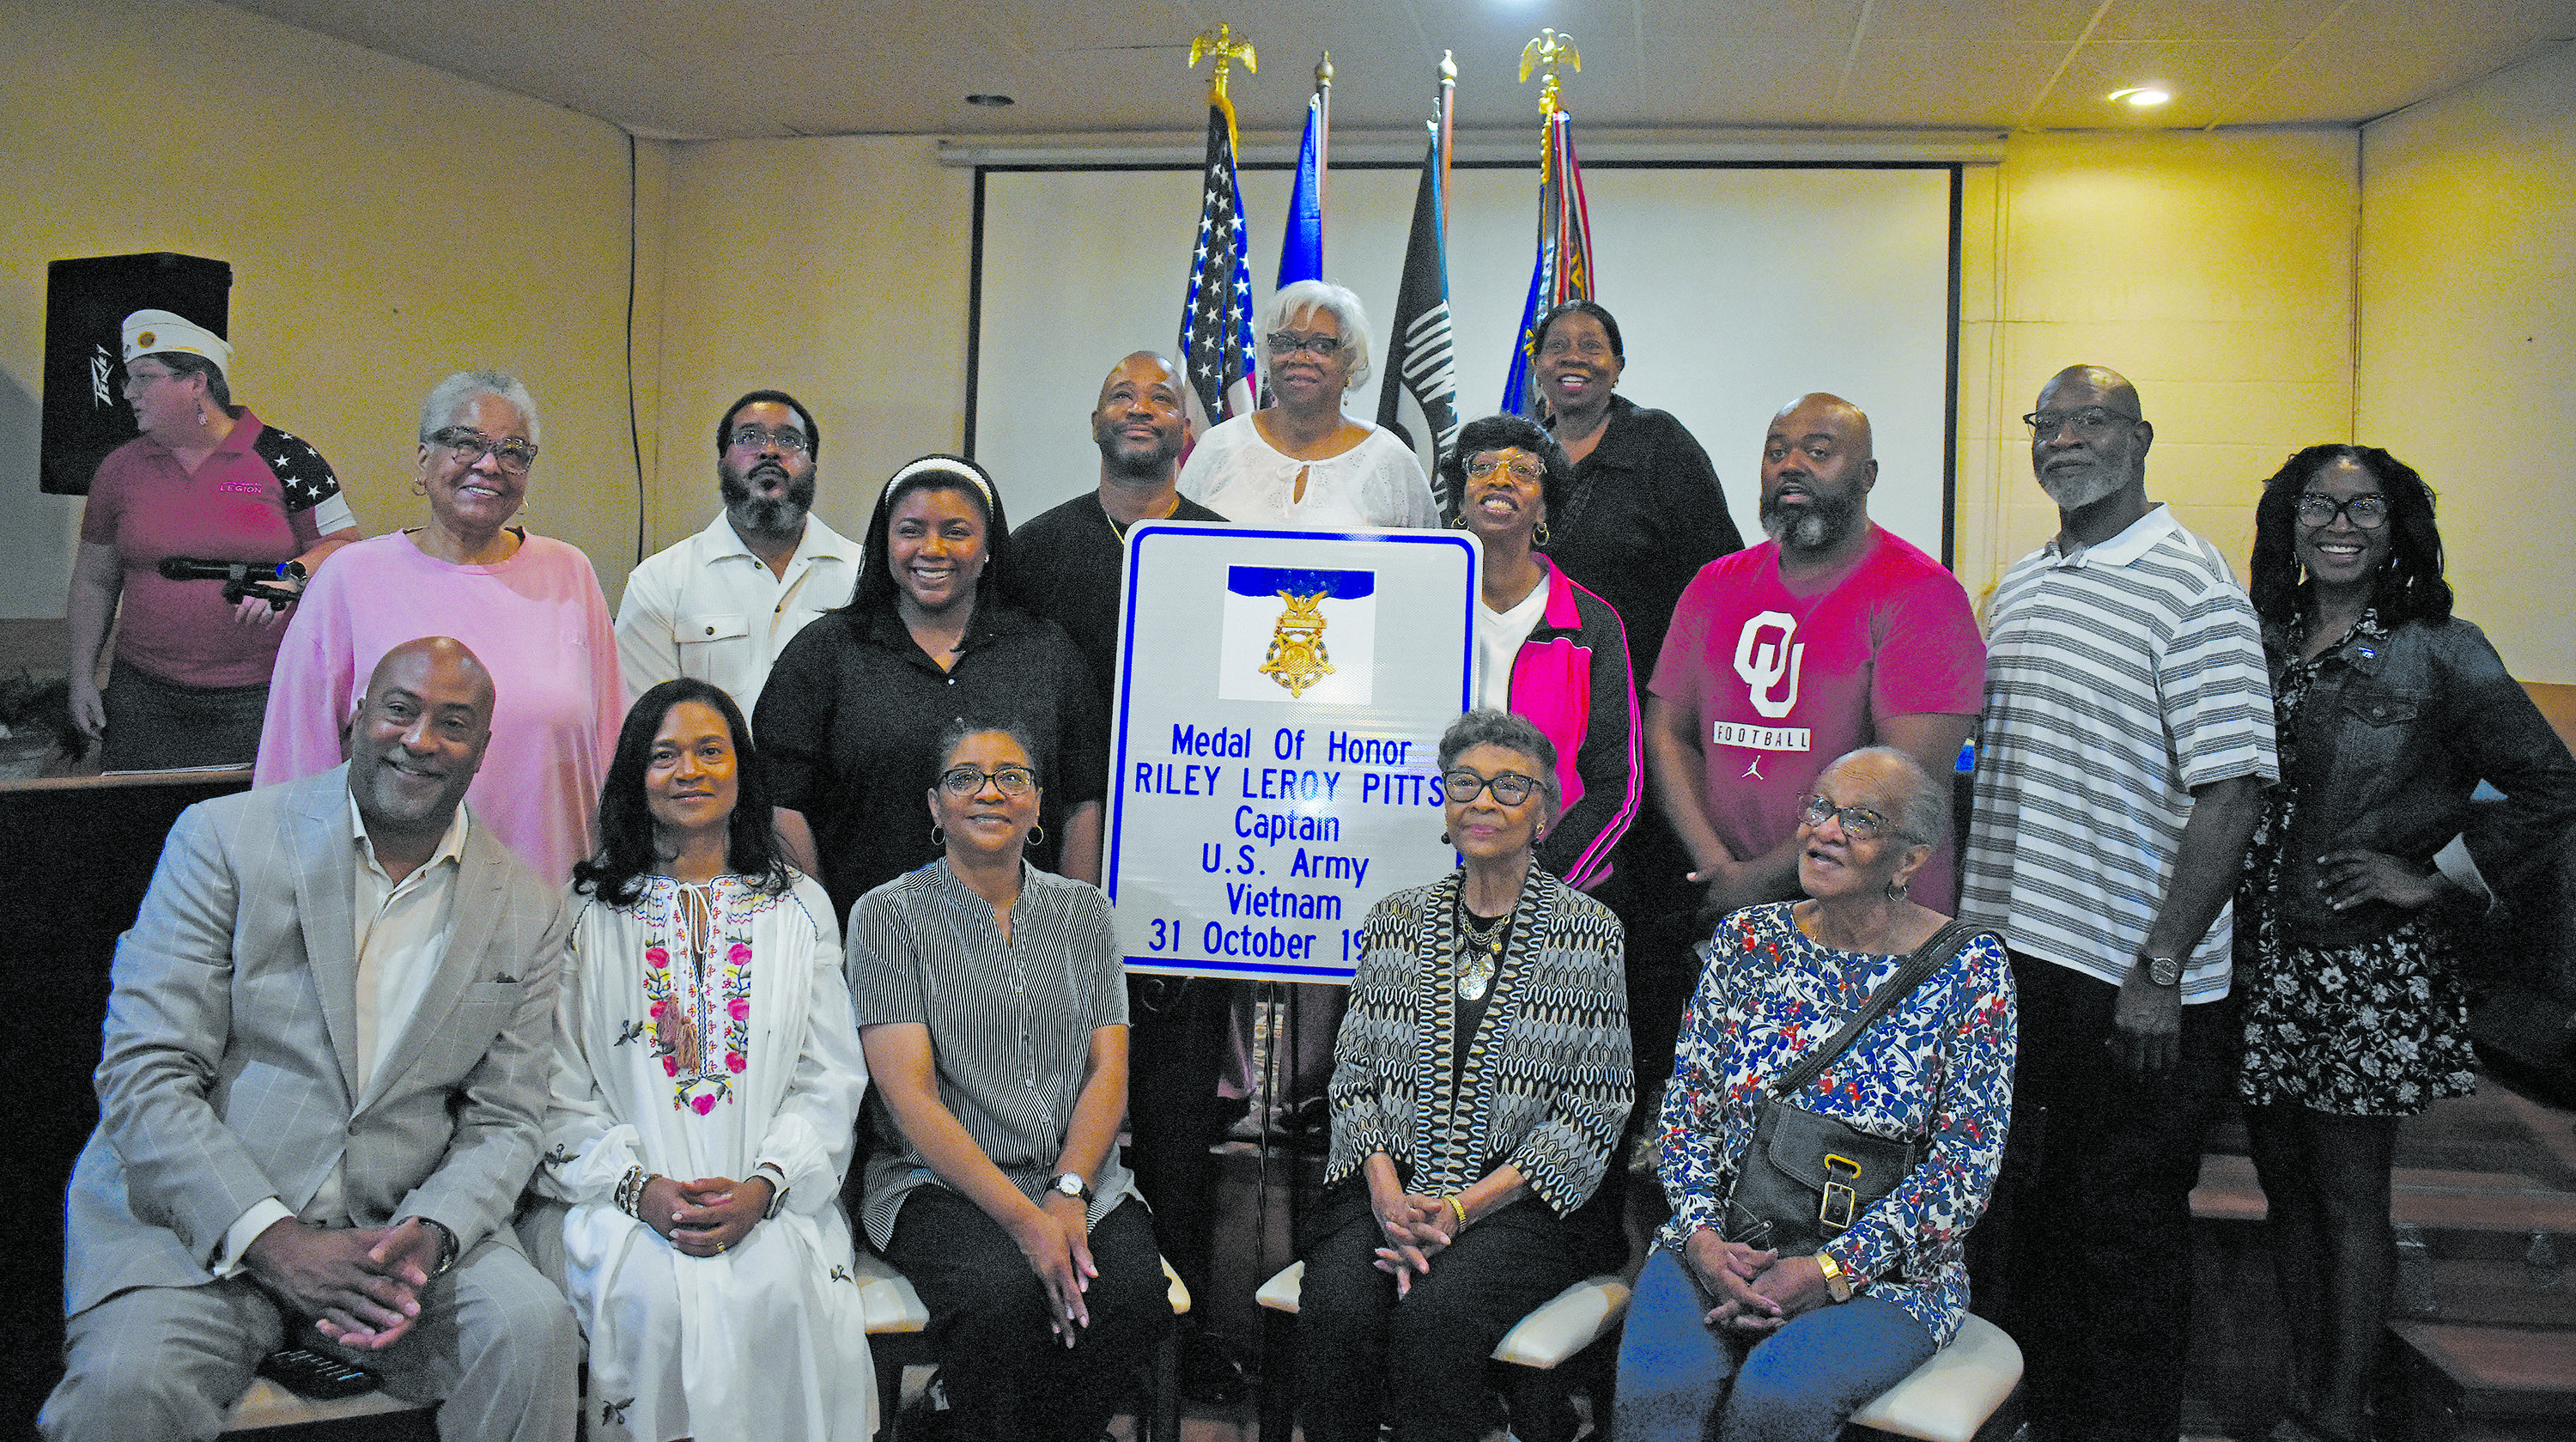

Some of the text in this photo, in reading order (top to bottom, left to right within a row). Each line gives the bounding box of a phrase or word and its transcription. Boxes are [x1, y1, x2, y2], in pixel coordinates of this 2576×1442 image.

[220, 484, 263, 495] LEGION
[1733, 610, 1806, 719] OU
[1172, 724, 1413, 765] Medal Of Honor
[1717, 726, 1807, 748] FOOTBALL
[1135, 763, 1444, 807] RILEY LEROY PITTS
[1235, 805, 1340, 848] Captain
[1202, 843, 1370, 889] U.S. Army
[1227, 883, 1341, 920] Vietnam
[1149, 918, 1180, 952] 31
[1203, 922, 1316, 959] October
